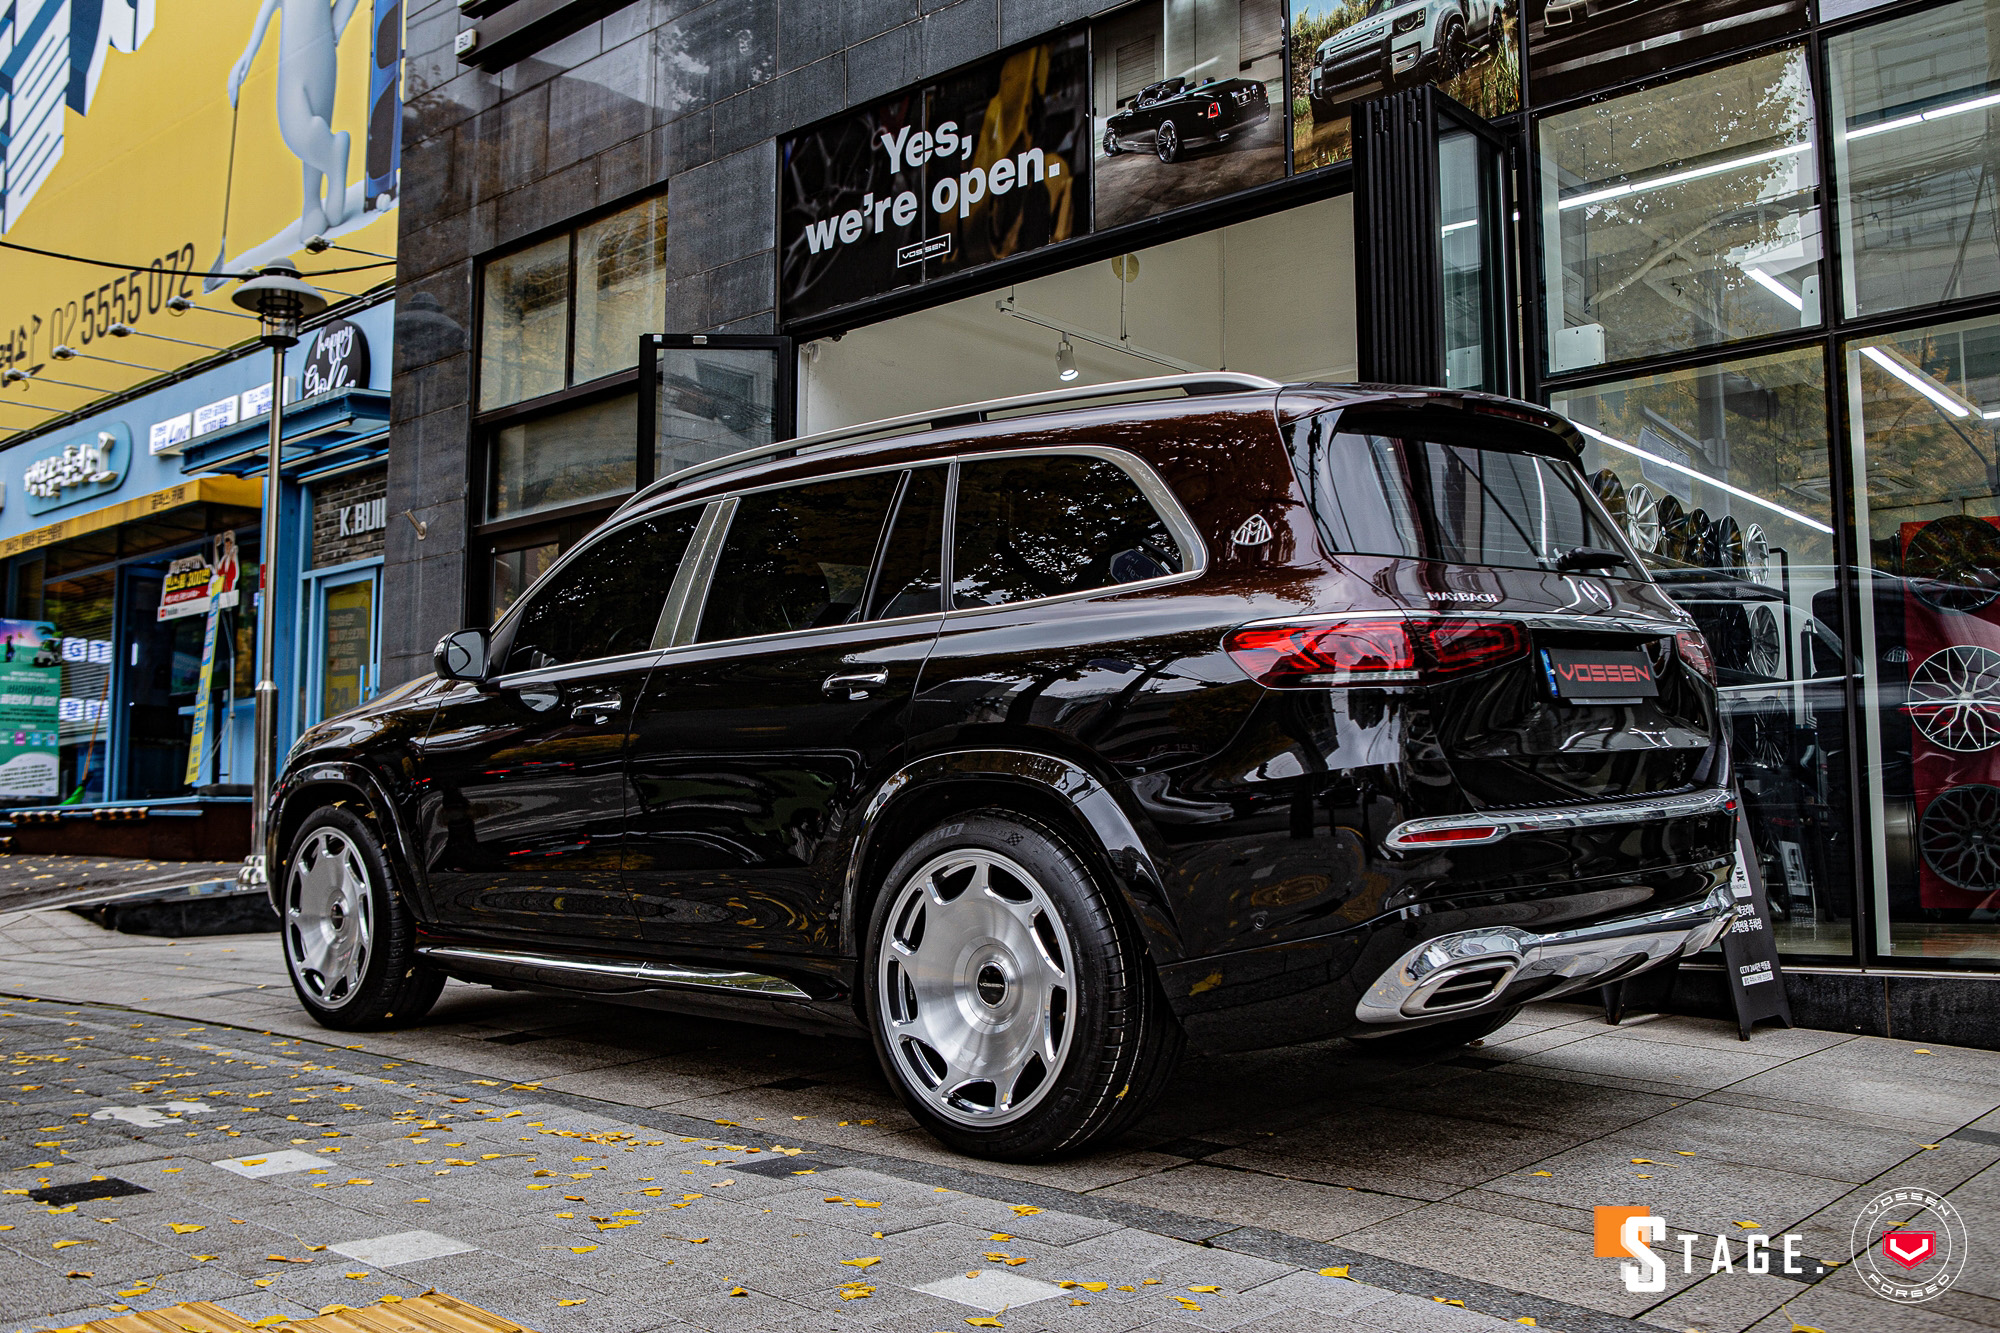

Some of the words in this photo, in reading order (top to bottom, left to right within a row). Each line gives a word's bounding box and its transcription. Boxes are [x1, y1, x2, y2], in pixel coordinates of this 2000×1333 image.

[880, 120, 972, 175] Yes,
[805, 190, 918, 255] we're
[931, 147, 1061, 219] open.
[902, 241, 946, 260] VOSSEN
[1426, 591, 1499, 603] MAYBACH
[1557, 663, 1651, 682] VOSSEN
